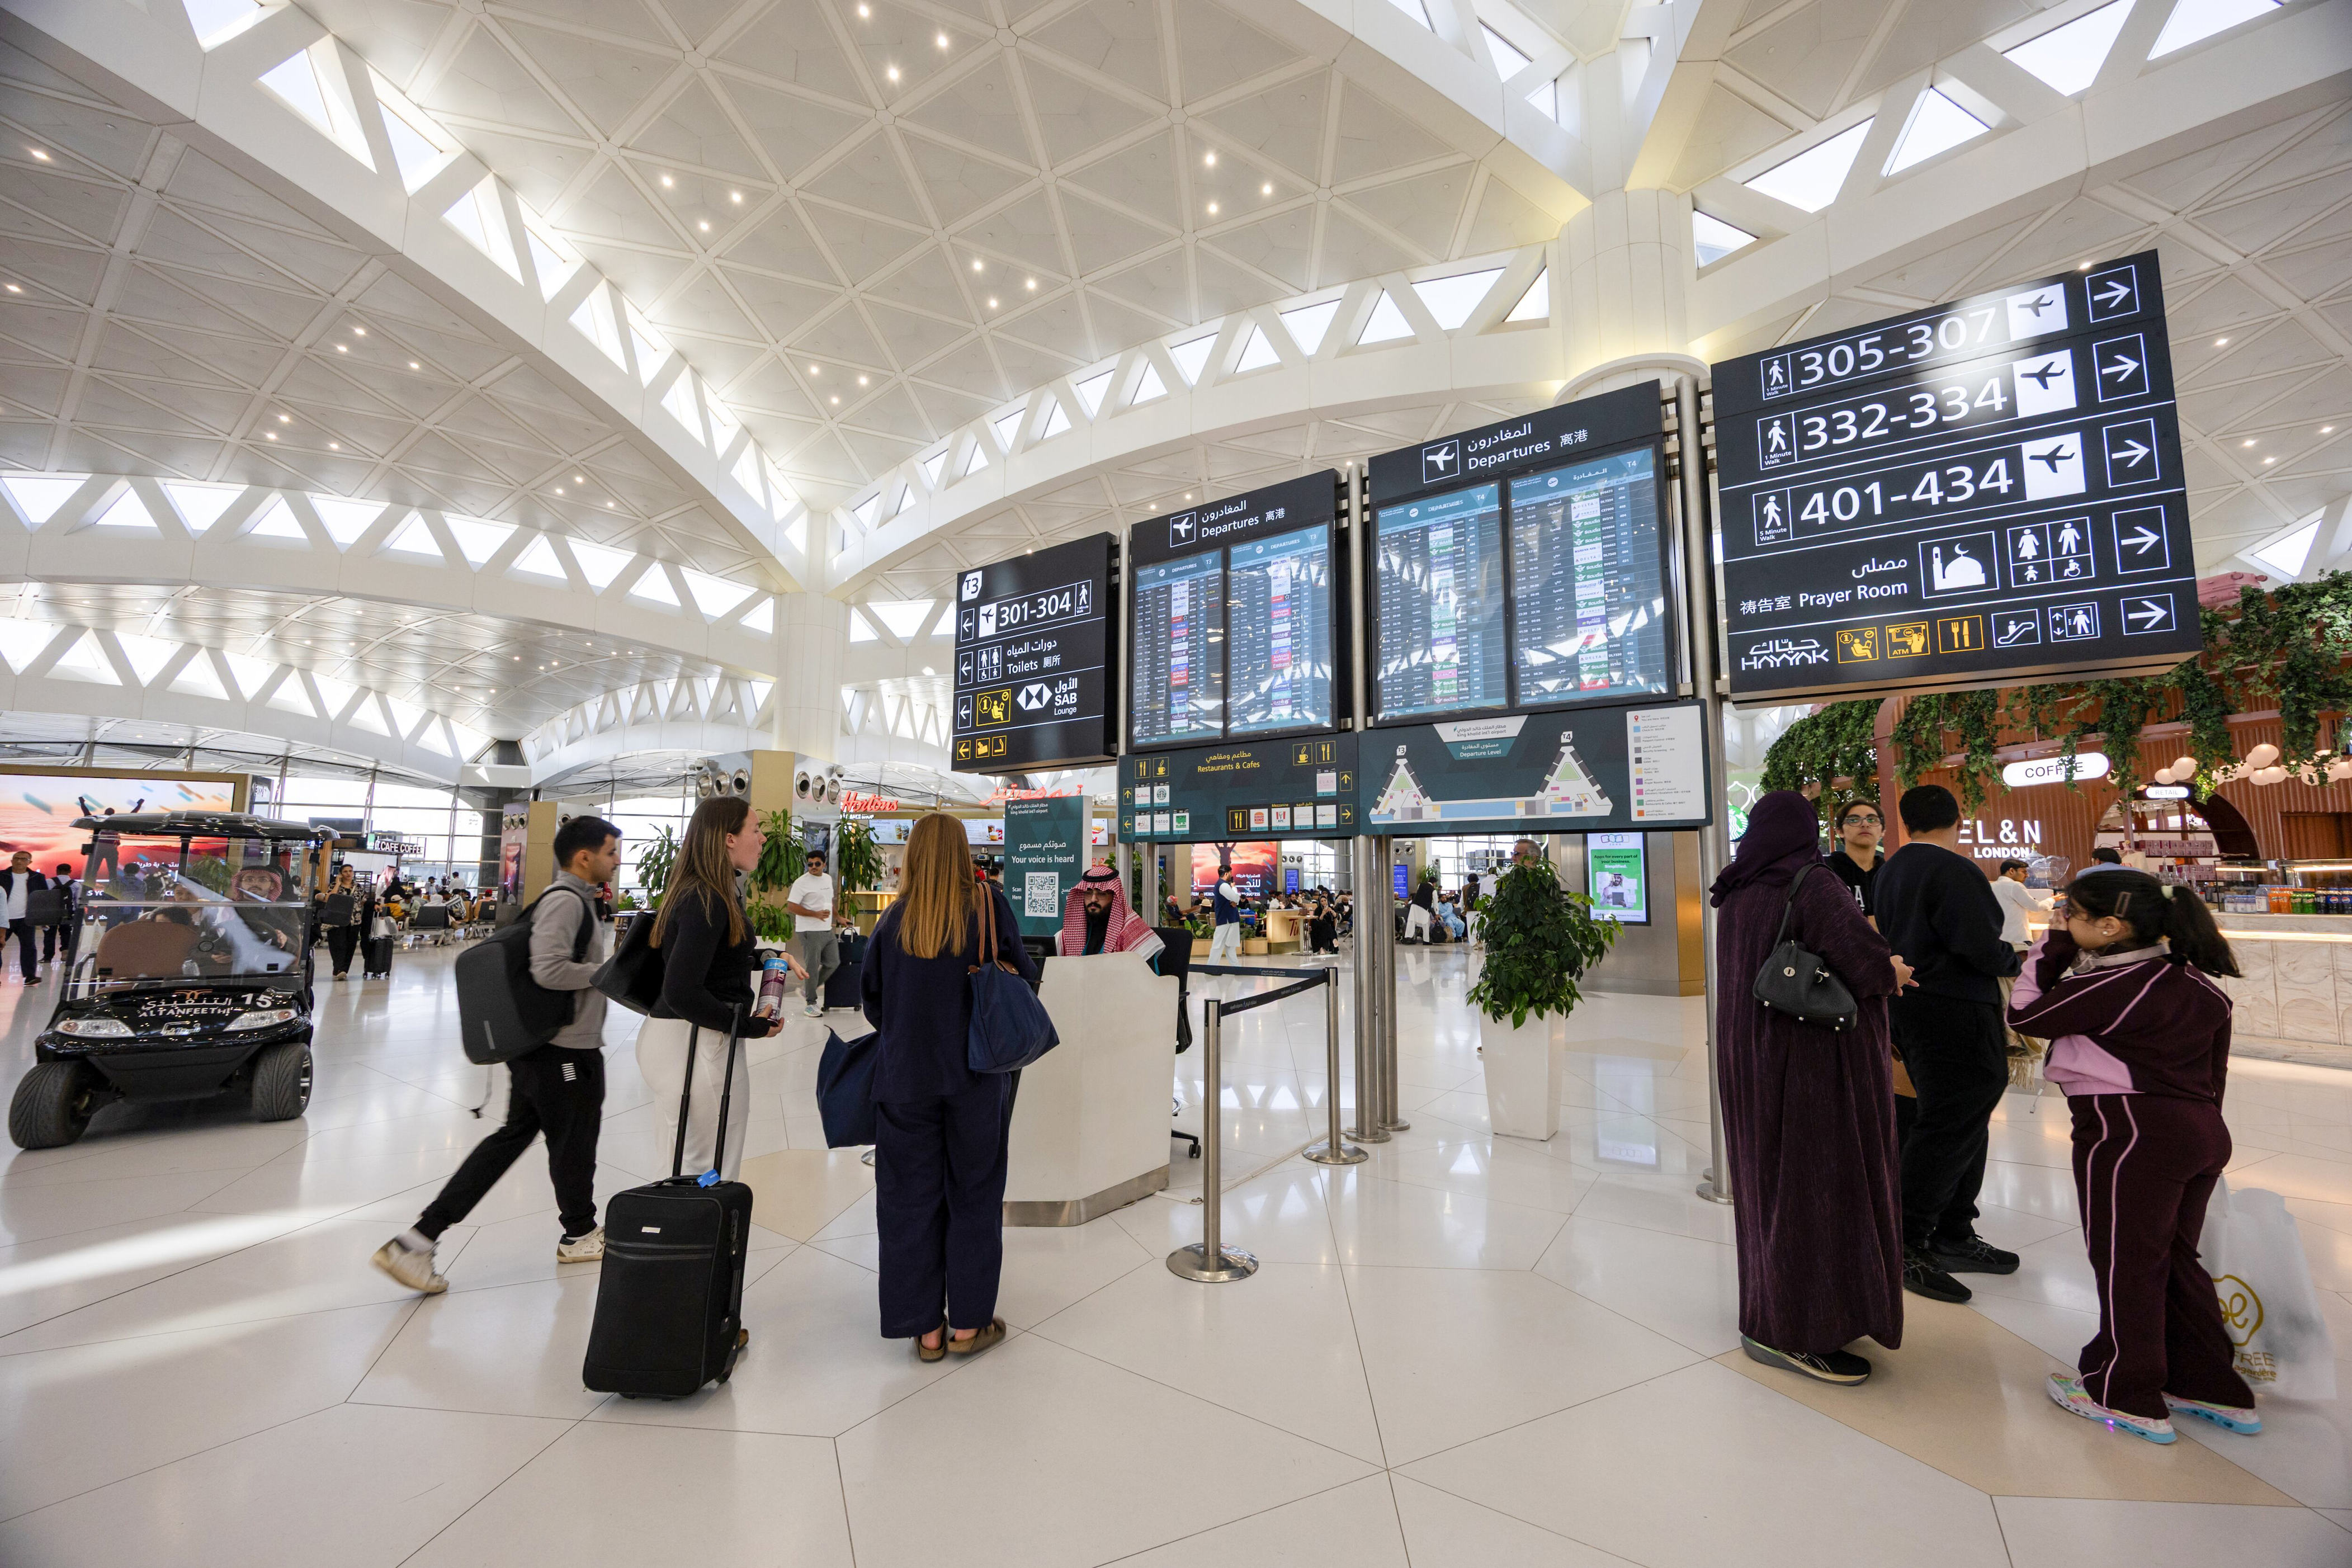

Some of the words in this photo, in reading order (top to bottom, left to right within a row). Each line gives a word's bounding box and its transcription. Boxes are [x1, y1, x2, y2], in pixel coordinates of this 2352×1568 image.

[1801, 308, 1996, 385] 305-307
[1803, 378, 2008, 450] 332-334
[1468, 423, 1532, 452] المغادرون
[1560, 429, 1588, 447] 离港
[1468, 440, 1550, 469] Departures
[1770, 451, 1792, 459] Minute
[1801, 459, 2013, 525] 401-434
[1202, 500, 1246, 523] المغادرون
[1265, 508, 1285, 522] 离港
[1202, 516, 1259, 537] Departures
[1765, 527, 1787, 535] Minute
[1271, 539, 1300, 549] DEPARTURES
[1172, 563, 1197, 573] DEPARTURES
[966, 577, 979, 594] T3
[1800, 589, 1852, 607] Prayer
[1857, 582, 1907, 599] Room
[999, 592, 1071, 627] 301-304
[1740, 596, 1792, 615] 祷告室
[1007, 642, 1029, 657] المياه
[1032, 640, 1057, 652] دورات
[1007, 660, 1038, 674] Toilets
[1055, 678, 1077, 694] الأول
[1055, 693, 1077, 706] SAB
[1054, 706, 1076, 716] Lounge
[1206, 753, 1230, 763] ومقاهي
[1232, 750, 1251, 761] مطاعم
[1198, 764, 1234, 772] Restaurants
[2025, 762, 2084, 778] COFFE
[840, 791, 899, 811] Hortons
[1019, 843, 1042, 852] مسموع
[1043, 840, 1066, 851] صوتكم
[1974, 847, 2030, 858] LONDON
[1054, 854, 1074, 863] heard
[241, 993, 272, 1008] 15
[2233, 1364, 2277, 1377] agardère
